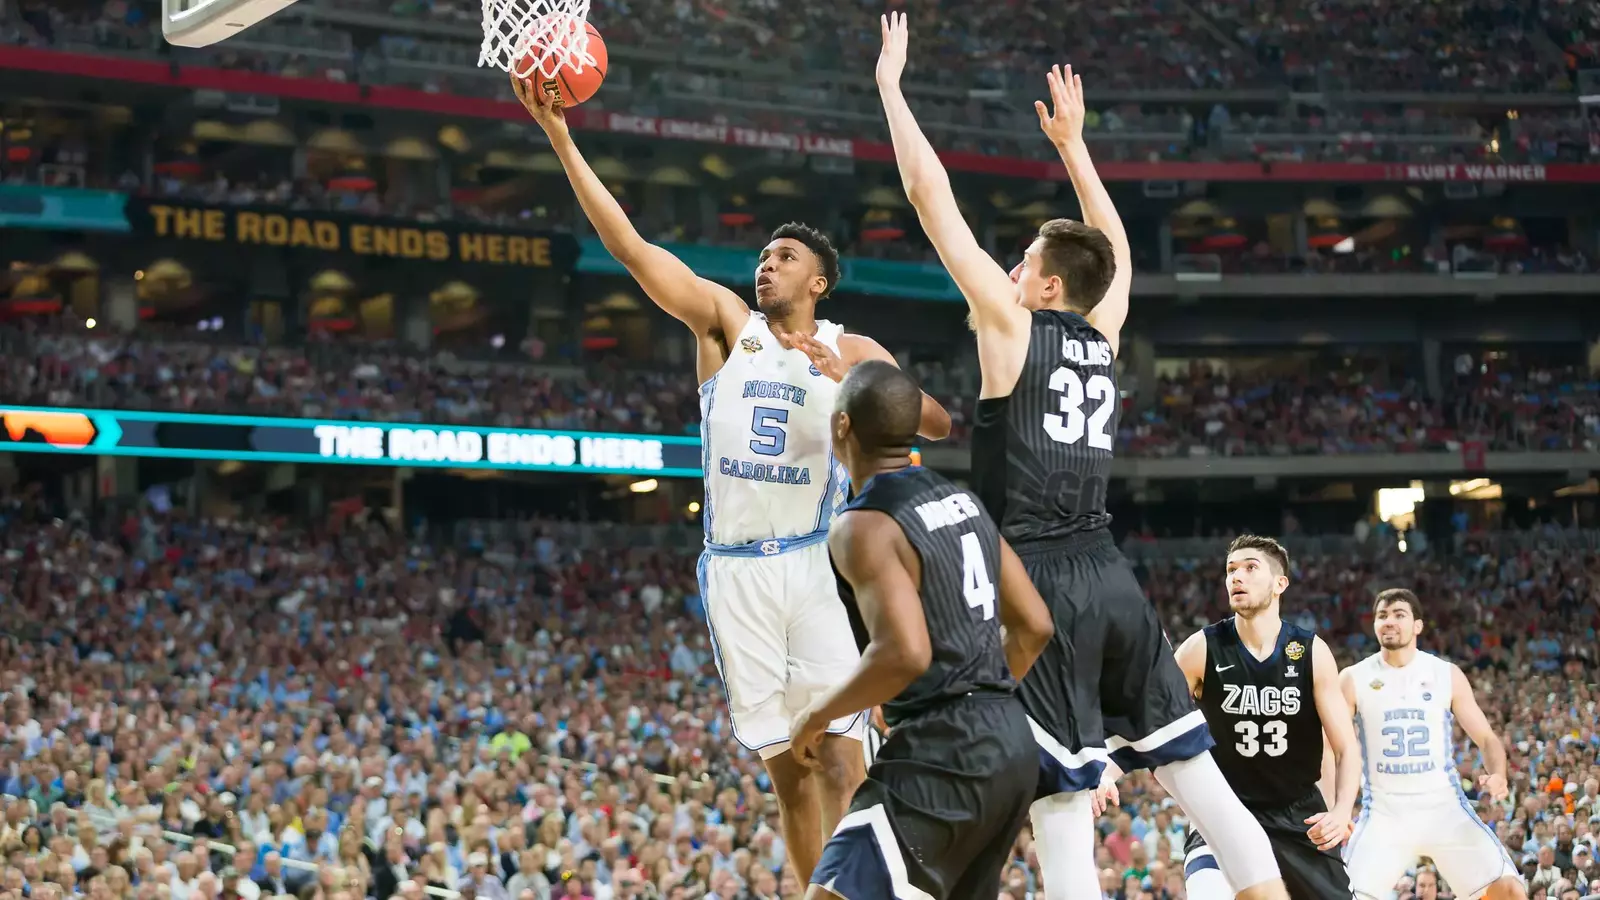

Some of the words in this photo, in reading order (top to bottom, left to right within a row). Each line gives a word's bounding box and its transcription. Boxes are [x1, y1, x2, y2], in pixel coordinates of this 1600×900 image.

[608, 113, 658, 134] DICK
[804, 135, 853, 154] LANE
[1407, 164, 1456, 180] KURT
[1465, 164, 1546, 180] WARNER
[148, 205, 225, 240] THE
[236, 212, 340, 250] ROAD
[351, 225, 449, 260] ENDS
[458, 232, 551, 266] HERE
[742, 380, 806, 406] NORTH
[1043, 366, 1115, 451] 32
[314, 425, 383, 459] THE
[388, 428, 483, 462] ROAD
[487, 432, 576, 466] ENDS
[580, 437, 663, 470] HERE
[749, 406, 788, 456] 5
[719, 457, 811, 484] CAROLINA
[960, 532, 995, 620] 4
[1221, 684, 1301, 716] ZAGS
[1384, 708, 1425, 721] NORTH
[1234, 720, 1288, 757] 33
[1382, 726, 1430, 757] 32
[1376, 761, 1437, 774] CAROLINA
